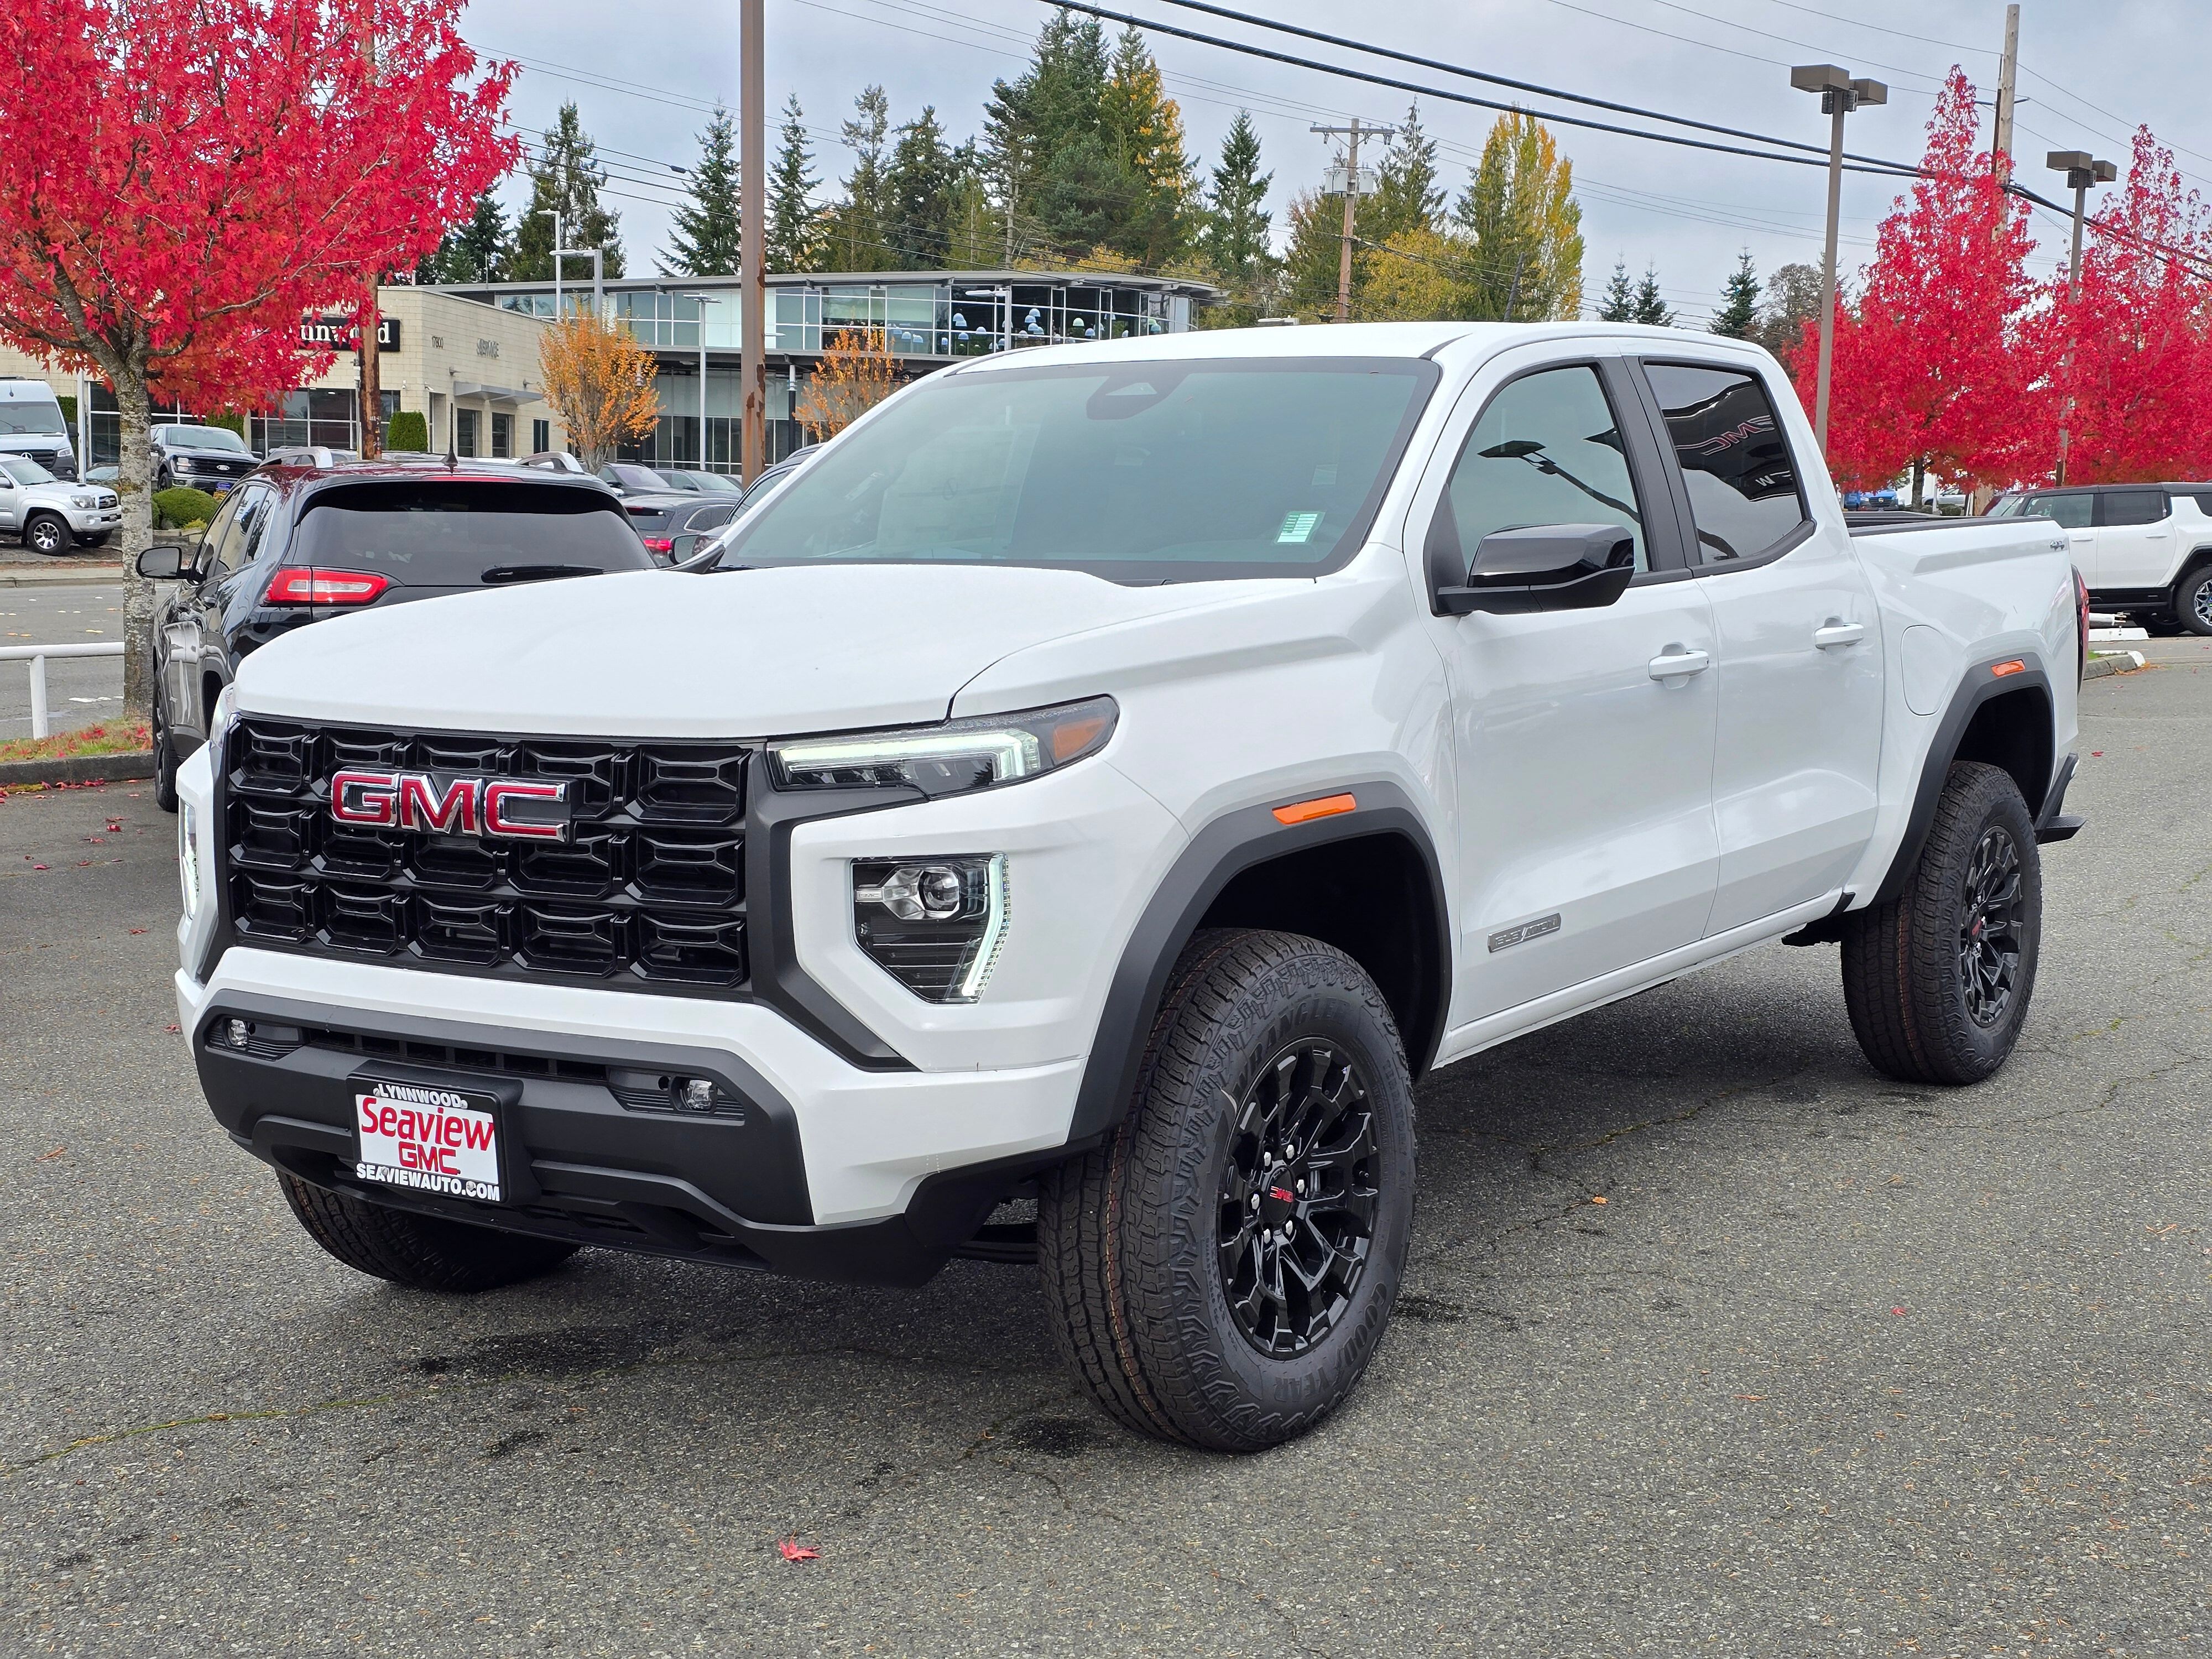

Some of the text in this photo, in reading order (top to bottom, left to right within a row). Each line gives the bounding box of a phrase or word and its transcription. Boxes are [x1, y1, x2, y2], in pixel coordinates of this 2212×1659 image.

[331, 771, 565, 842] GMC
[378, 1084, 461, 1108] LYNNWOOD
[361, 1097, 495, 1151] Seaview
[398, 1141, 460, 1175] GMC
[356, 1163, 500, 1201] SEAVIEWAUTO.COM
[1274, 1281, 1387, 1402] GOODYEAR
